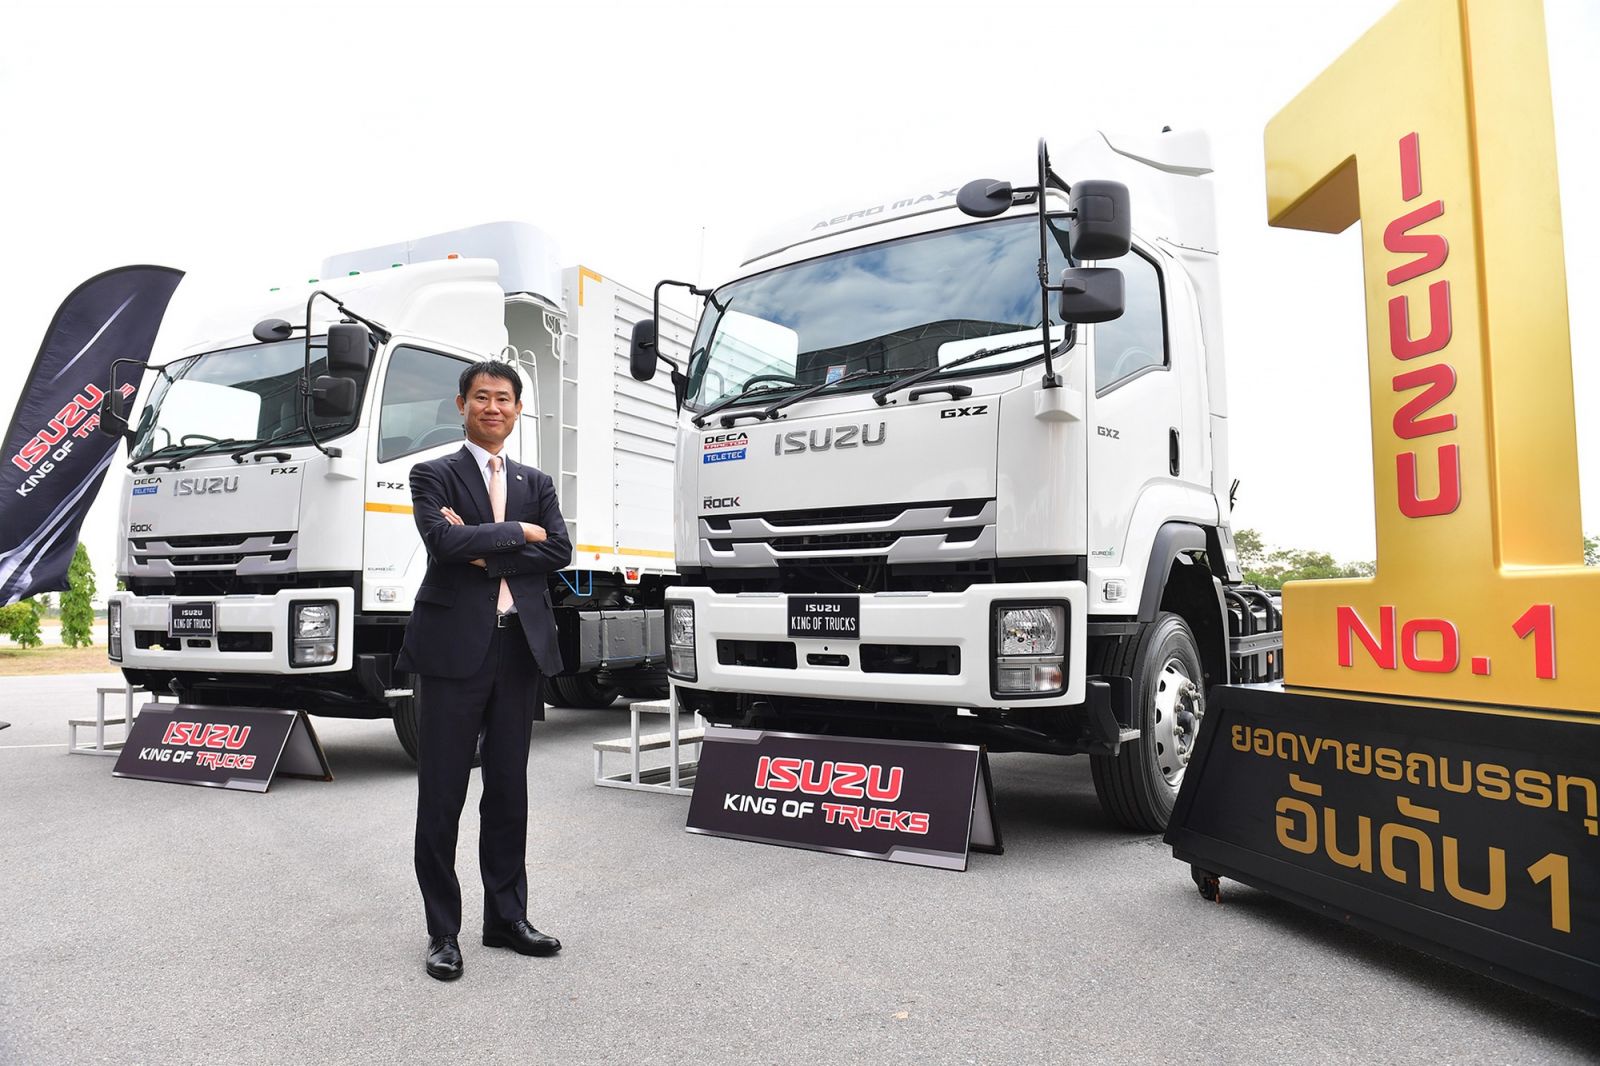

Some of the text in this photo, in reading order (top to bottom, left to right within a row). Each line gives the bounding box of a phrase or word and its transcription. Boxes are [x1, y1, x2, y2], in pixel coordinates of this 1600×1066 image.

[811, 187, 960, 230] AERO MAX
[1383, 131, 1462, 519] ISUZU
[940, 405, 988, 419] GXZ
[11, 383, 105, 472] ISUZU
[1096, 425, 1120, 440] GXZ
[15, 382, 136, 497] KING OF TRS
[704, 432, 748, 444] DECA
[774, 422, 886, 456] ISUZU
[705, 450, 744, 462] TELETEC
[270, 466, 298, 475] FXZ
[133, 477, 162, 485] DECA
[173, 476, 239, 496] ISUZU
[376, 481, 405, 490] FXZ
[703, 496, 741, 509] ROCK
[130, 523, 153, 533] ROCK
[805, 604, 841, 612] ISUZU
[173, 618, 212, 629] KING OF TRUCKS
[791, 616, 856, 631] KING OF TRUCKS
[162, 721, 251, 750] ISUZU
[138, 747, 256, 771] KING OF TRUCKS
[754, 755, 904, 802] ISUZU
[723, 793, 930, 835] KING OF TRUCKS
[1275, 773, 1572, 933] อันดับ 1
